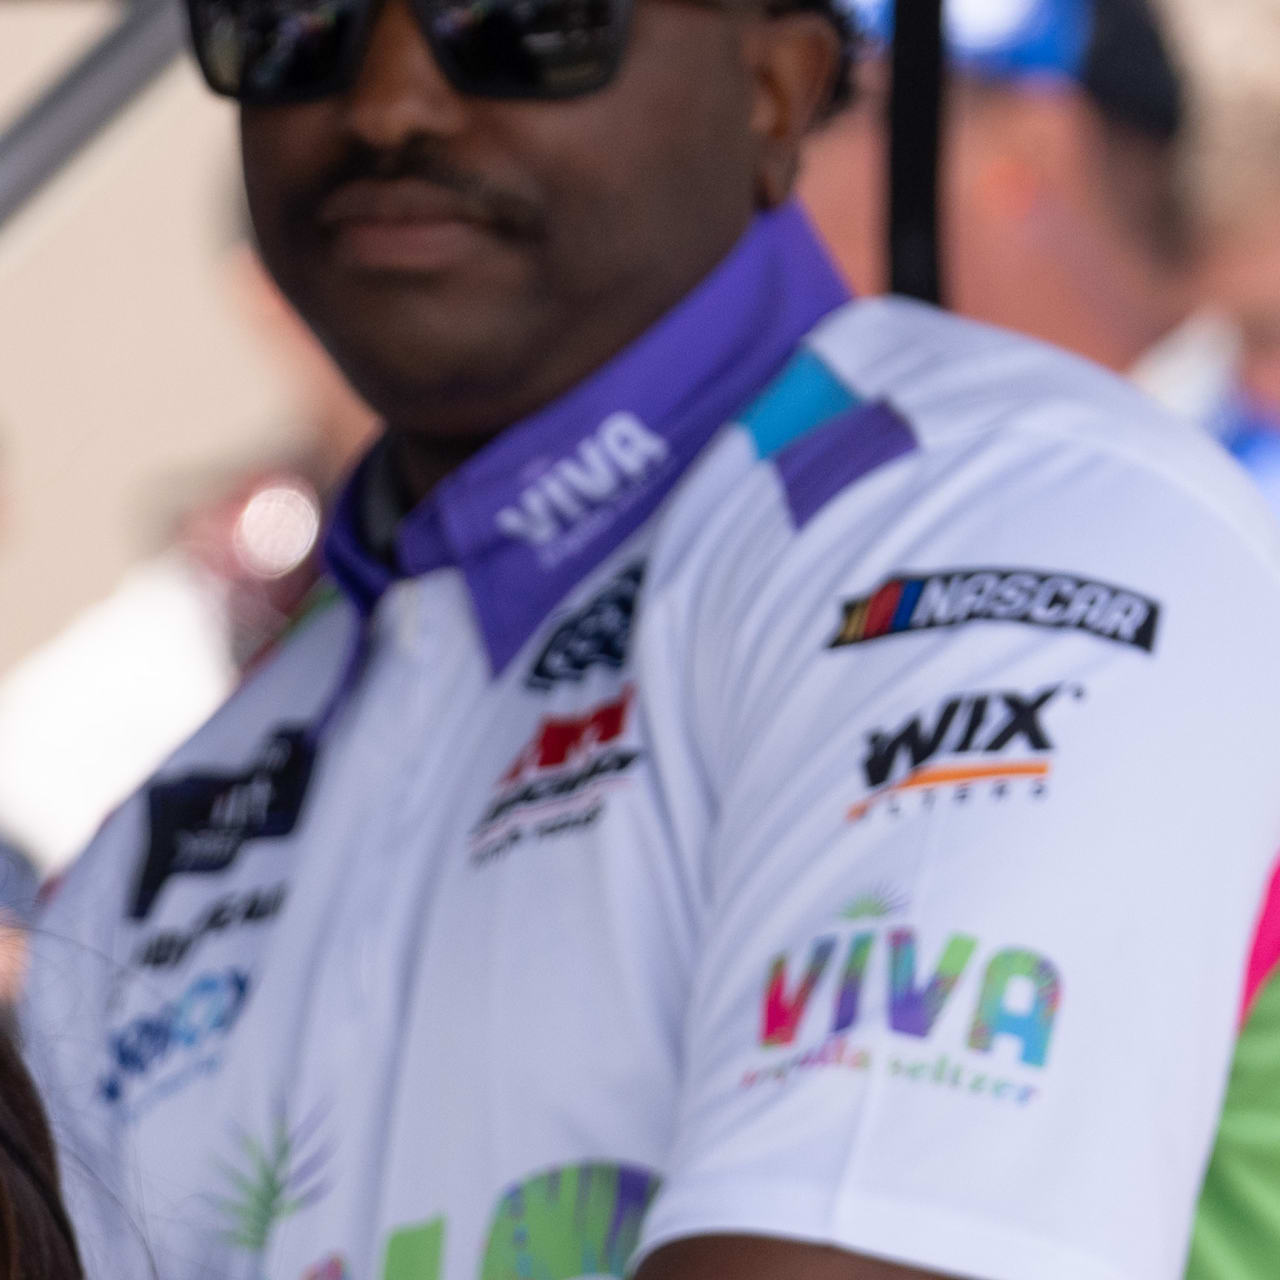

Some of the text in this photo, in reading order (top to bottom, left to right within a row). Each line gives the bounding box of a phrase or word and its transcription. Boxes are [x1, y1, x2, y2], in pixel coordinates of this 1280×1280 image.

[496, 412, 668, 543] VIVA
[908, 575, 1143, 640] NASCAR
[862, 684, 1062, 788] WIX
[757, 928, 1063, 1068] VIVA
